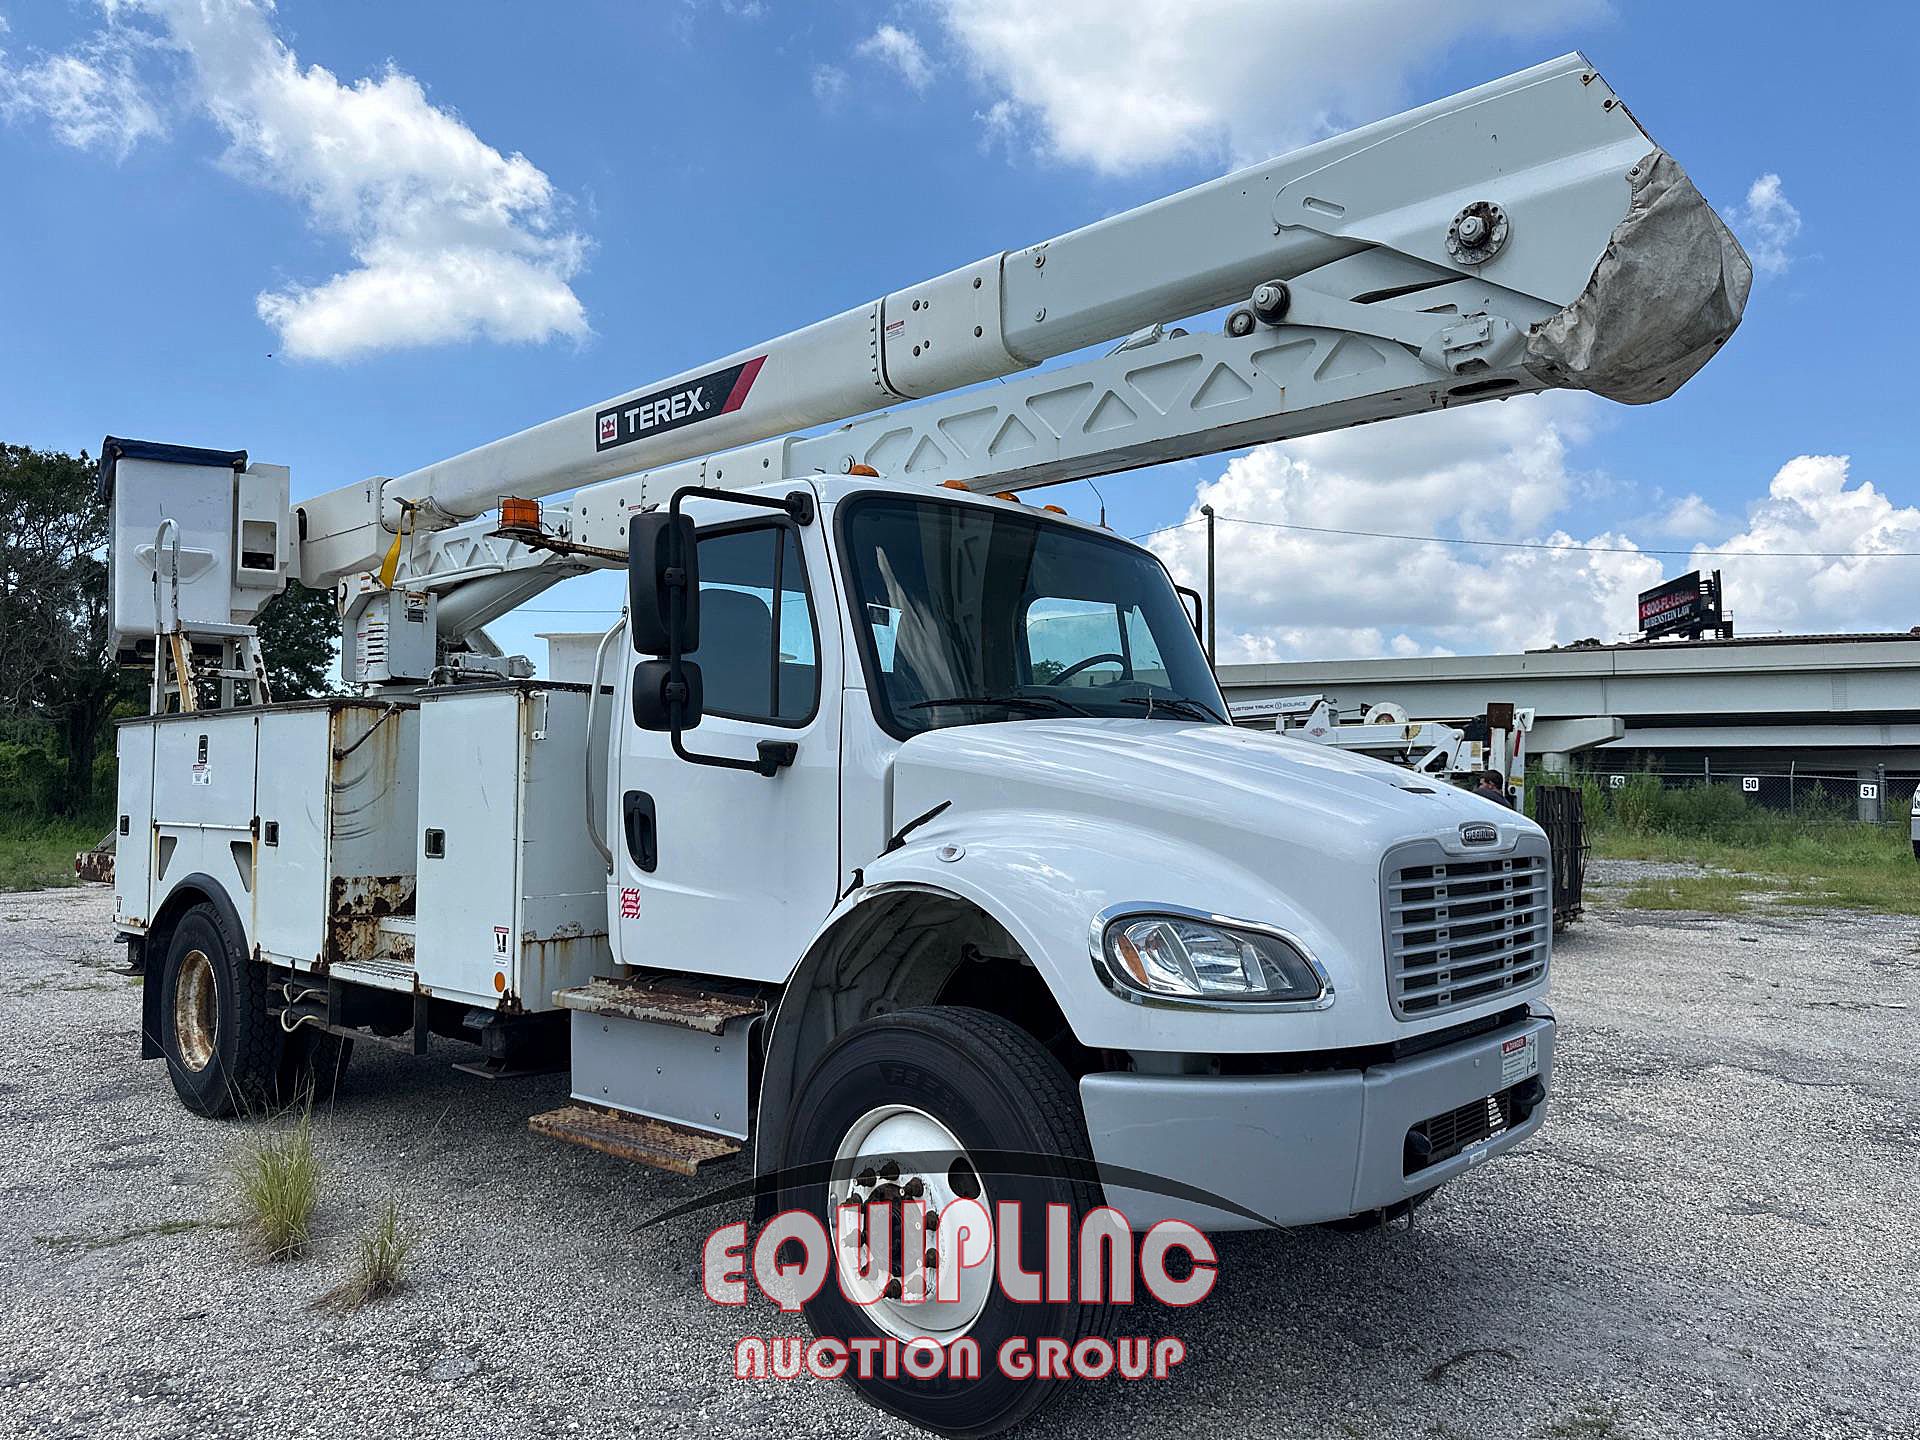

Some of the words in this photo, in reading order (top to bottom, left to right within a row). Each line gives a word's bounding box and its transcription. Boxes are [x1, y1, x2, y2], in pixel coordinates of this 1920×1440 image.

[624, 386, 705, 433] TEREX
[1745, 780, 1757, 789] 50
[1863, 786, 1875, 797] 51
